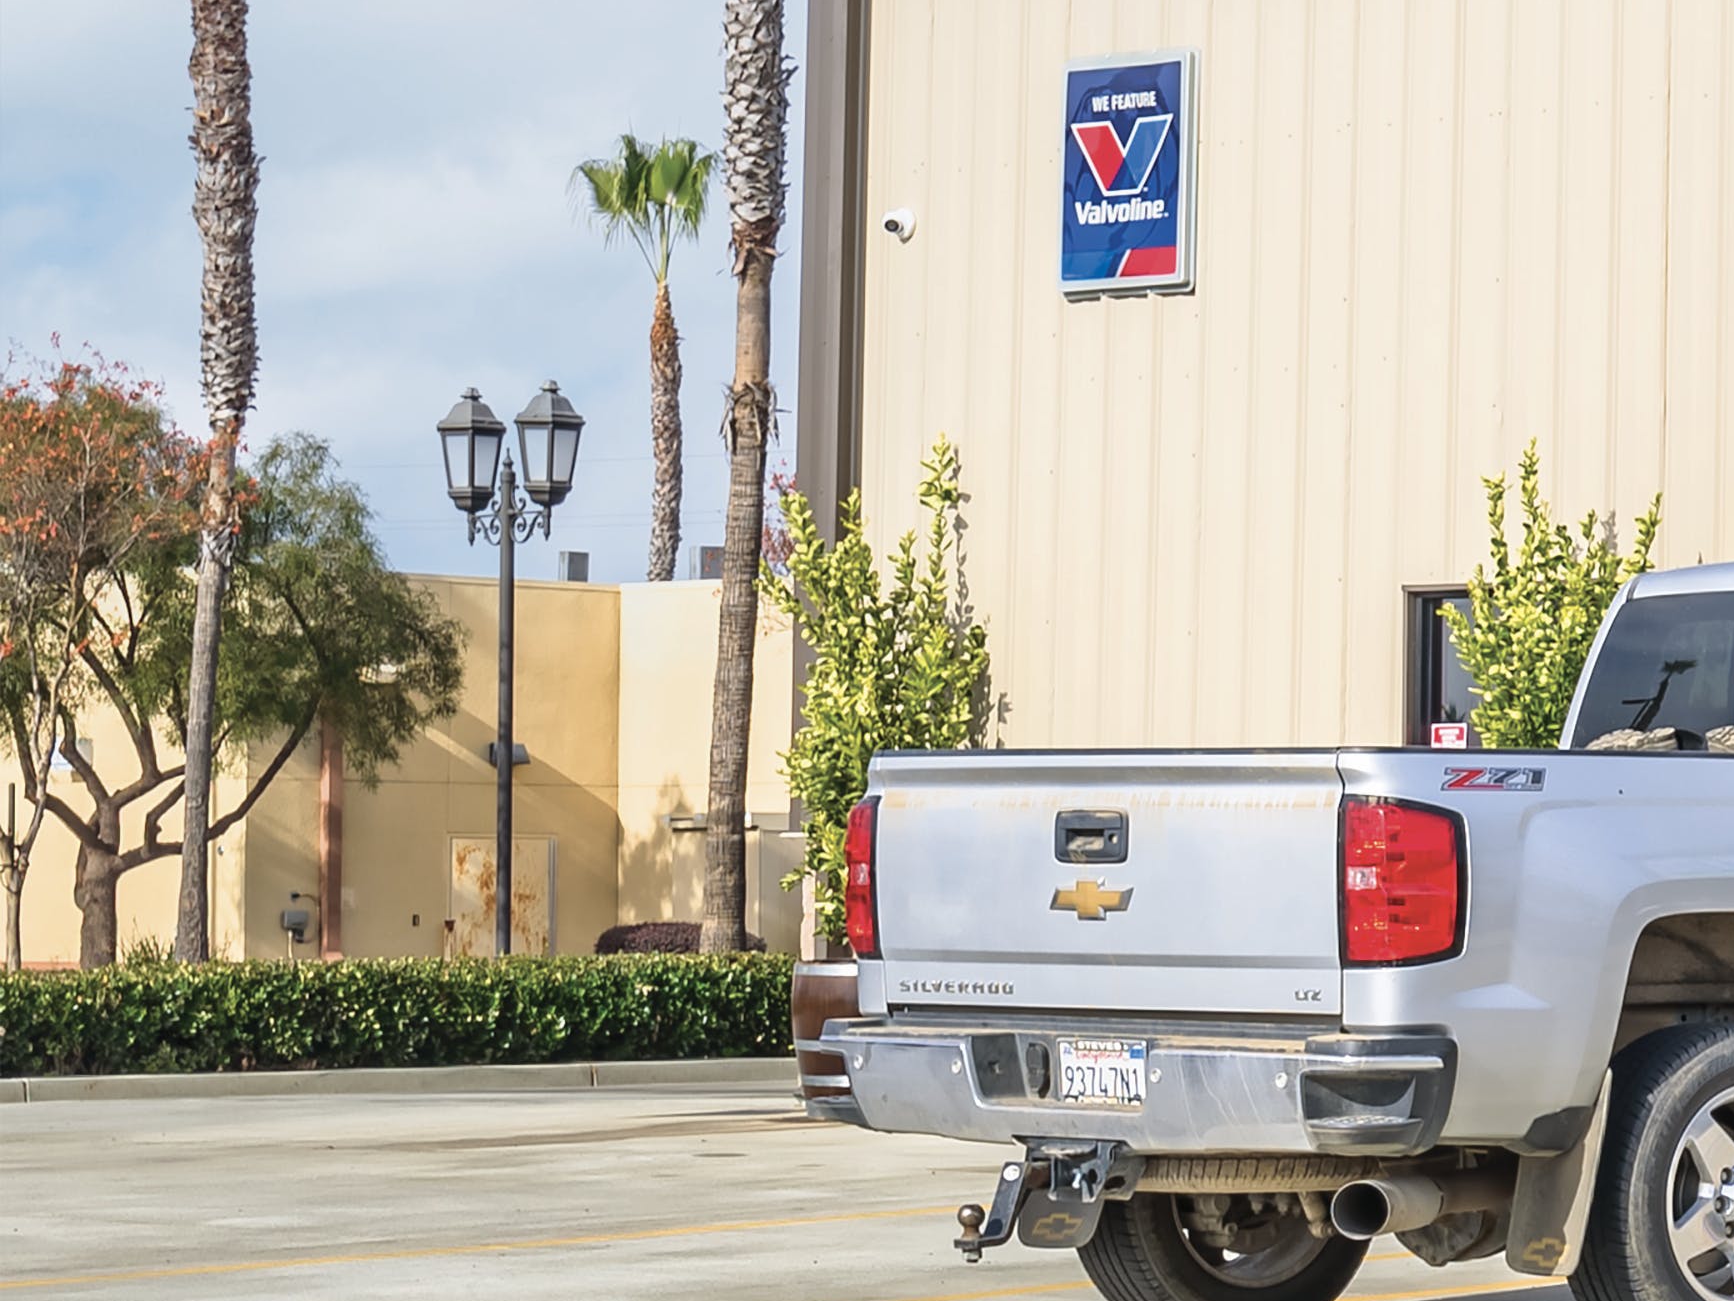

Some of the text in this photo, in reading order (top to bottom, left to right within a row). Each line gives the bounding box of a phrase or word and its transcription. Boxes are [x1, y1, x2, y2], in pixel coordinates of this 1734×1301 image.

[1091, 90, 1157, 113] WE FEATURE
[1074, 197, 1165, 225] Valvoline
[1440, 766, 1547, 792] Z71
